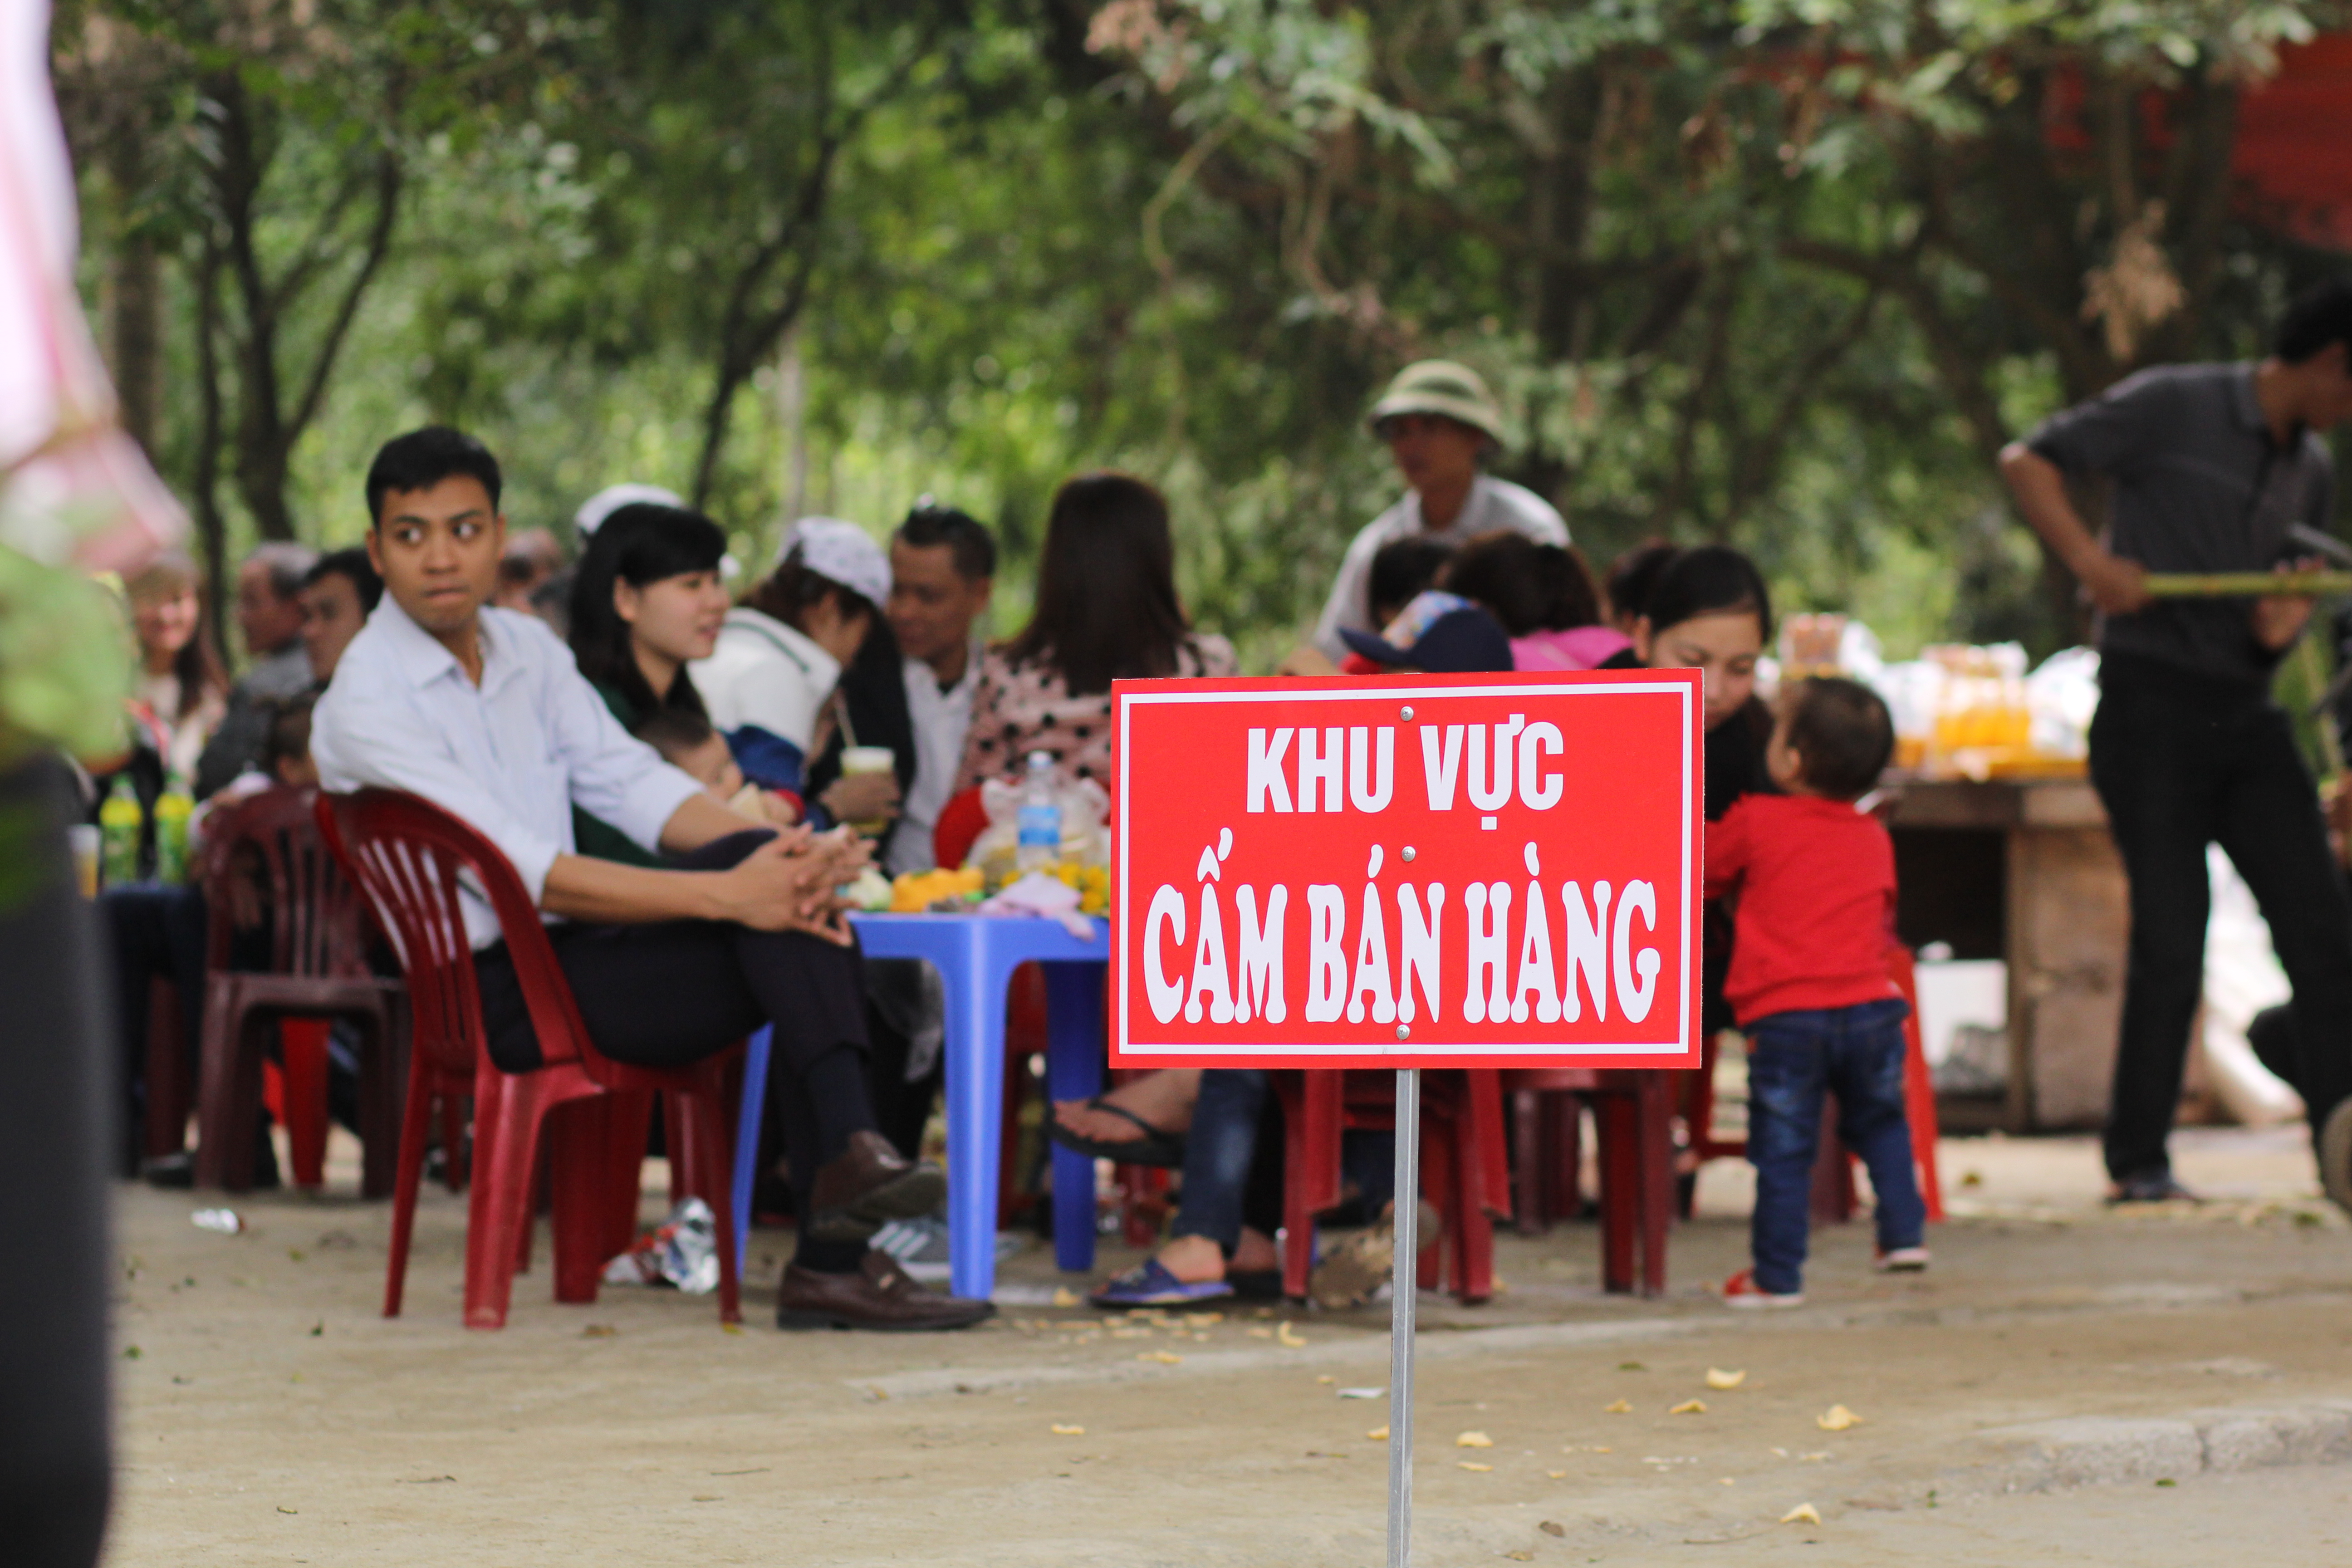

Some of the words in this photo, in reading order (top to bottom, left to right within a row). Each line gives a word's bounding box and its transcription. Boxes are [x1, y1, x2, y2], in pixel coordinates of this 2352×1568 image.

[1247, 727, 1395, 813] KHU
[1420, 714, 1563, 830] VỰC
[1143, 827, 1288, 1024] CẤM
[1305, 844, 1445, 1024] BÁN
[1463, 842, 1661, 1024] HÀNG
